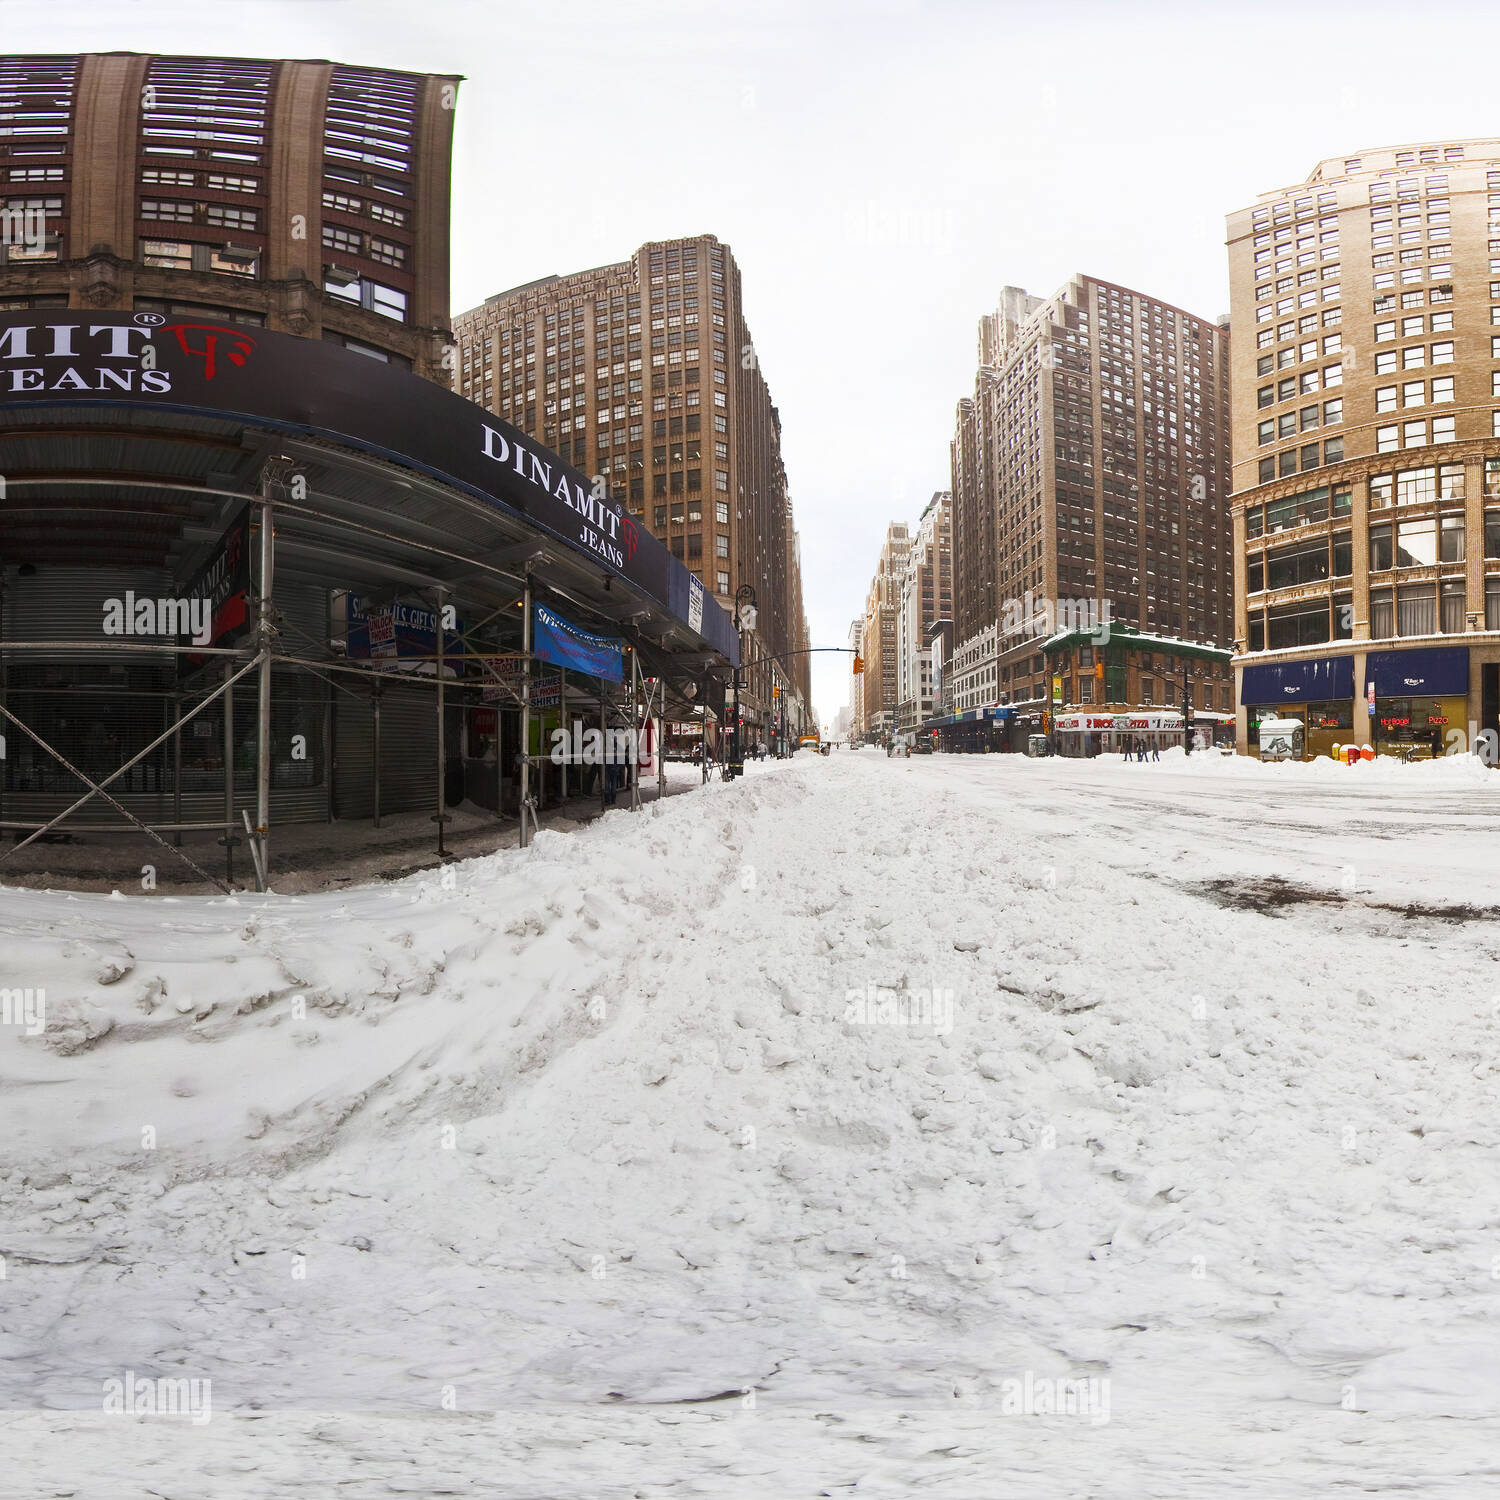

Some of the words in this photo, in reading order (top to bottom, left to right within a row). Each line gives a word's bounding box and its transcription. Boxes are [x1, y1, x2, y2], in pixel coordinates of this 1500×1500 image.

[4, 366, 172, 393] EANS
[480, 423, 621, 540] DINAMIT
[579, 525, 623, 568] JEANS
[1086, 719, 1092, 729] 2
[1428, 716, 1449, 724] Pizza
